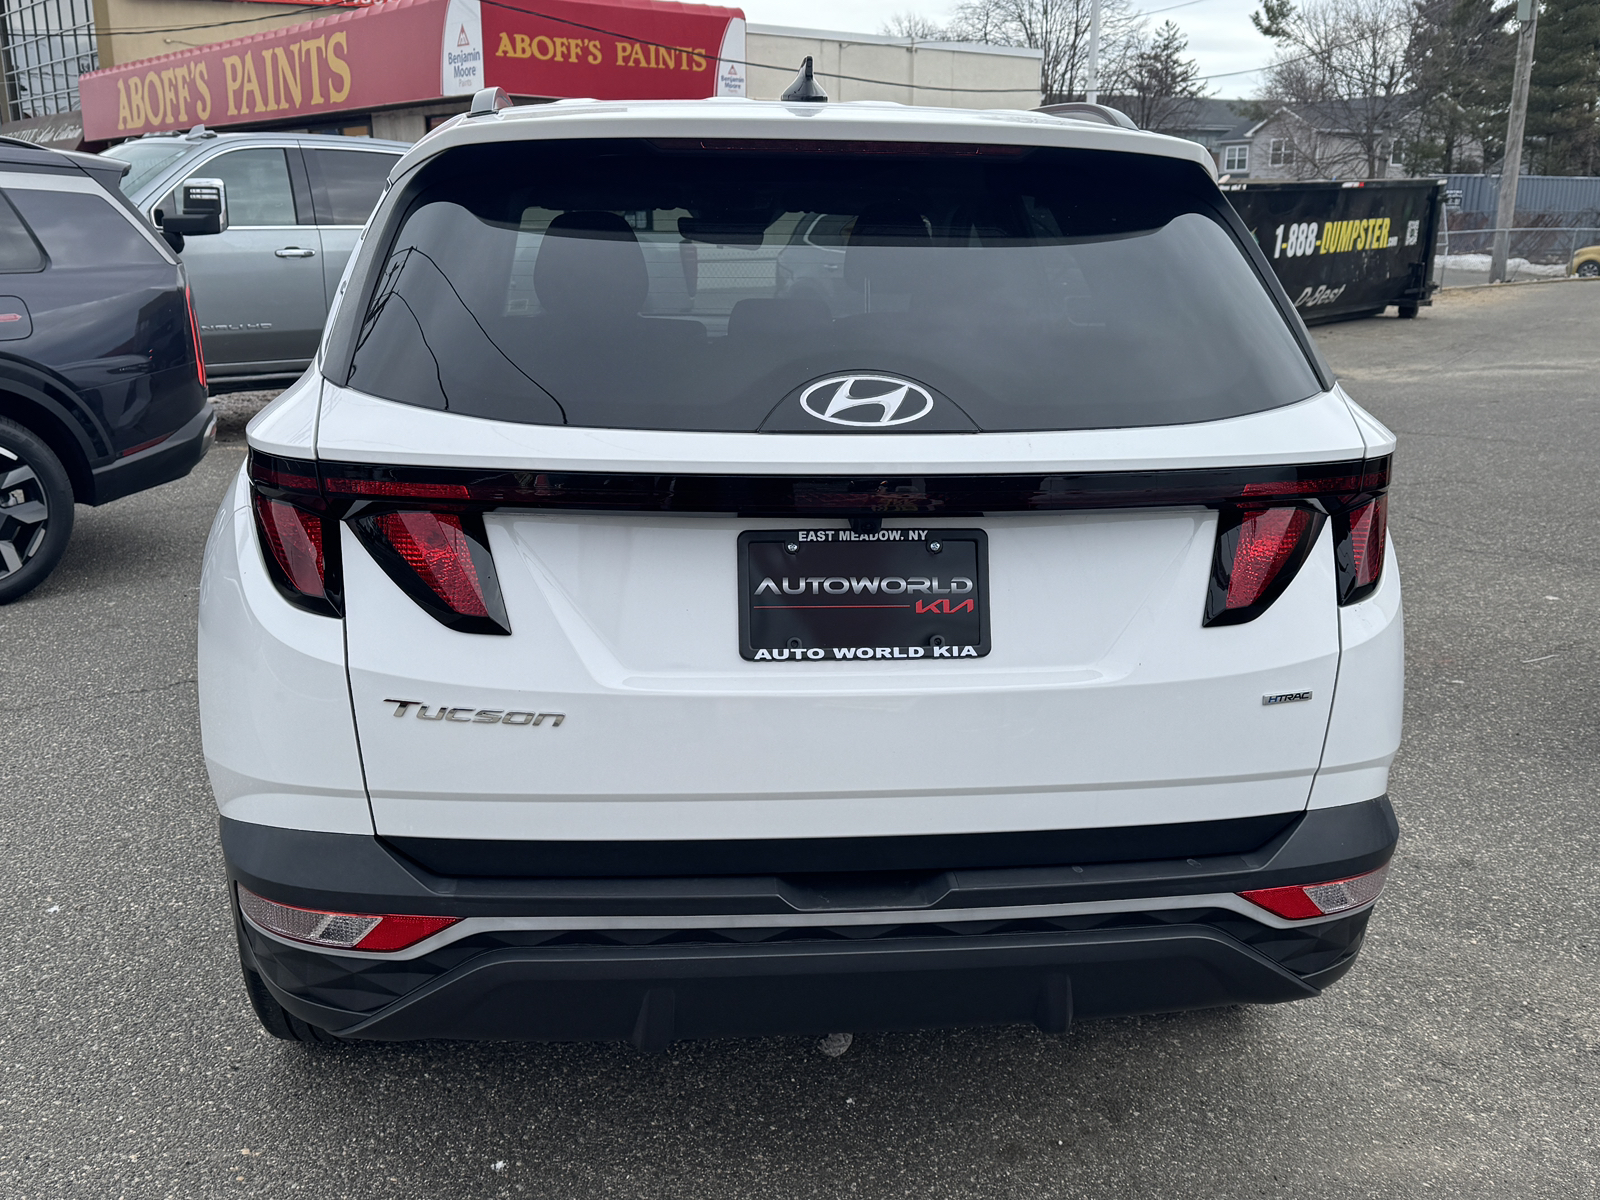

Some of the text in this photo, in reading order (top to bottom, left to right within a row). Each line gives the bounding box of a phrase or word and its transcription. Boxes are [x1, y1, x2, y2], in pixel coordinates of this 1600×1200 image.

[447, 48, 480, 66] Benjamin
[495, 32, 707, 71] ABOFF'S PAINTS
[453, 65, 476, 78] Moore
[117, 31, 352, 130] ABOFF'S PAINTS
[798, 531, 835, 542] EAST
[908, 530, 928, 541] NY
[753, 576, 974, 595] AUTOWORLD
[915, 598, 974, 614] KIA
[754, 645, 978, 660] AUTO WORLD KIA
[1267, 691, 1310, 703] HTRAC
